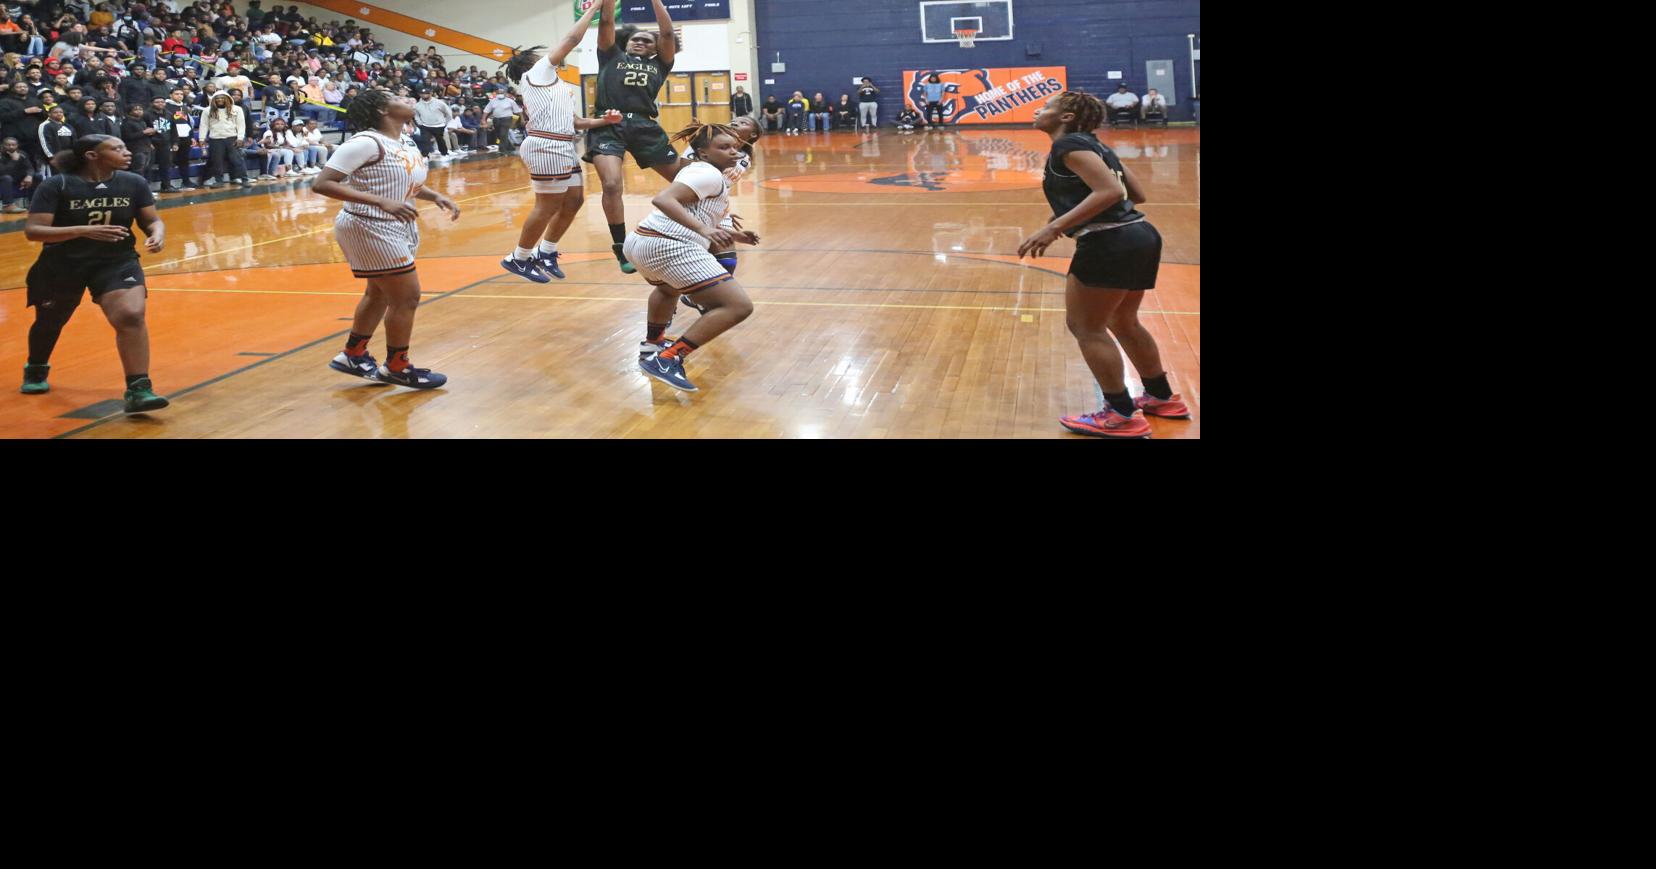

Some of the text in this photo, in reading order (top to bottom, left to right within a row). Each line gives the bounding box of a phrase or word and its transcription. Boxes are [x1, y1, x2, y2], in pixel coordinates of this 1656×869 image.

[616, 62, 658, 74] EAGLES
[623, 71, 648, 87] 23
[975, 71, 1045, 104] HOME OF THE
[974, 77, 1063, 120] PANTHERS
[70, 198, 130, 209] EAGLES
[88, 210, 112, 225] 21
